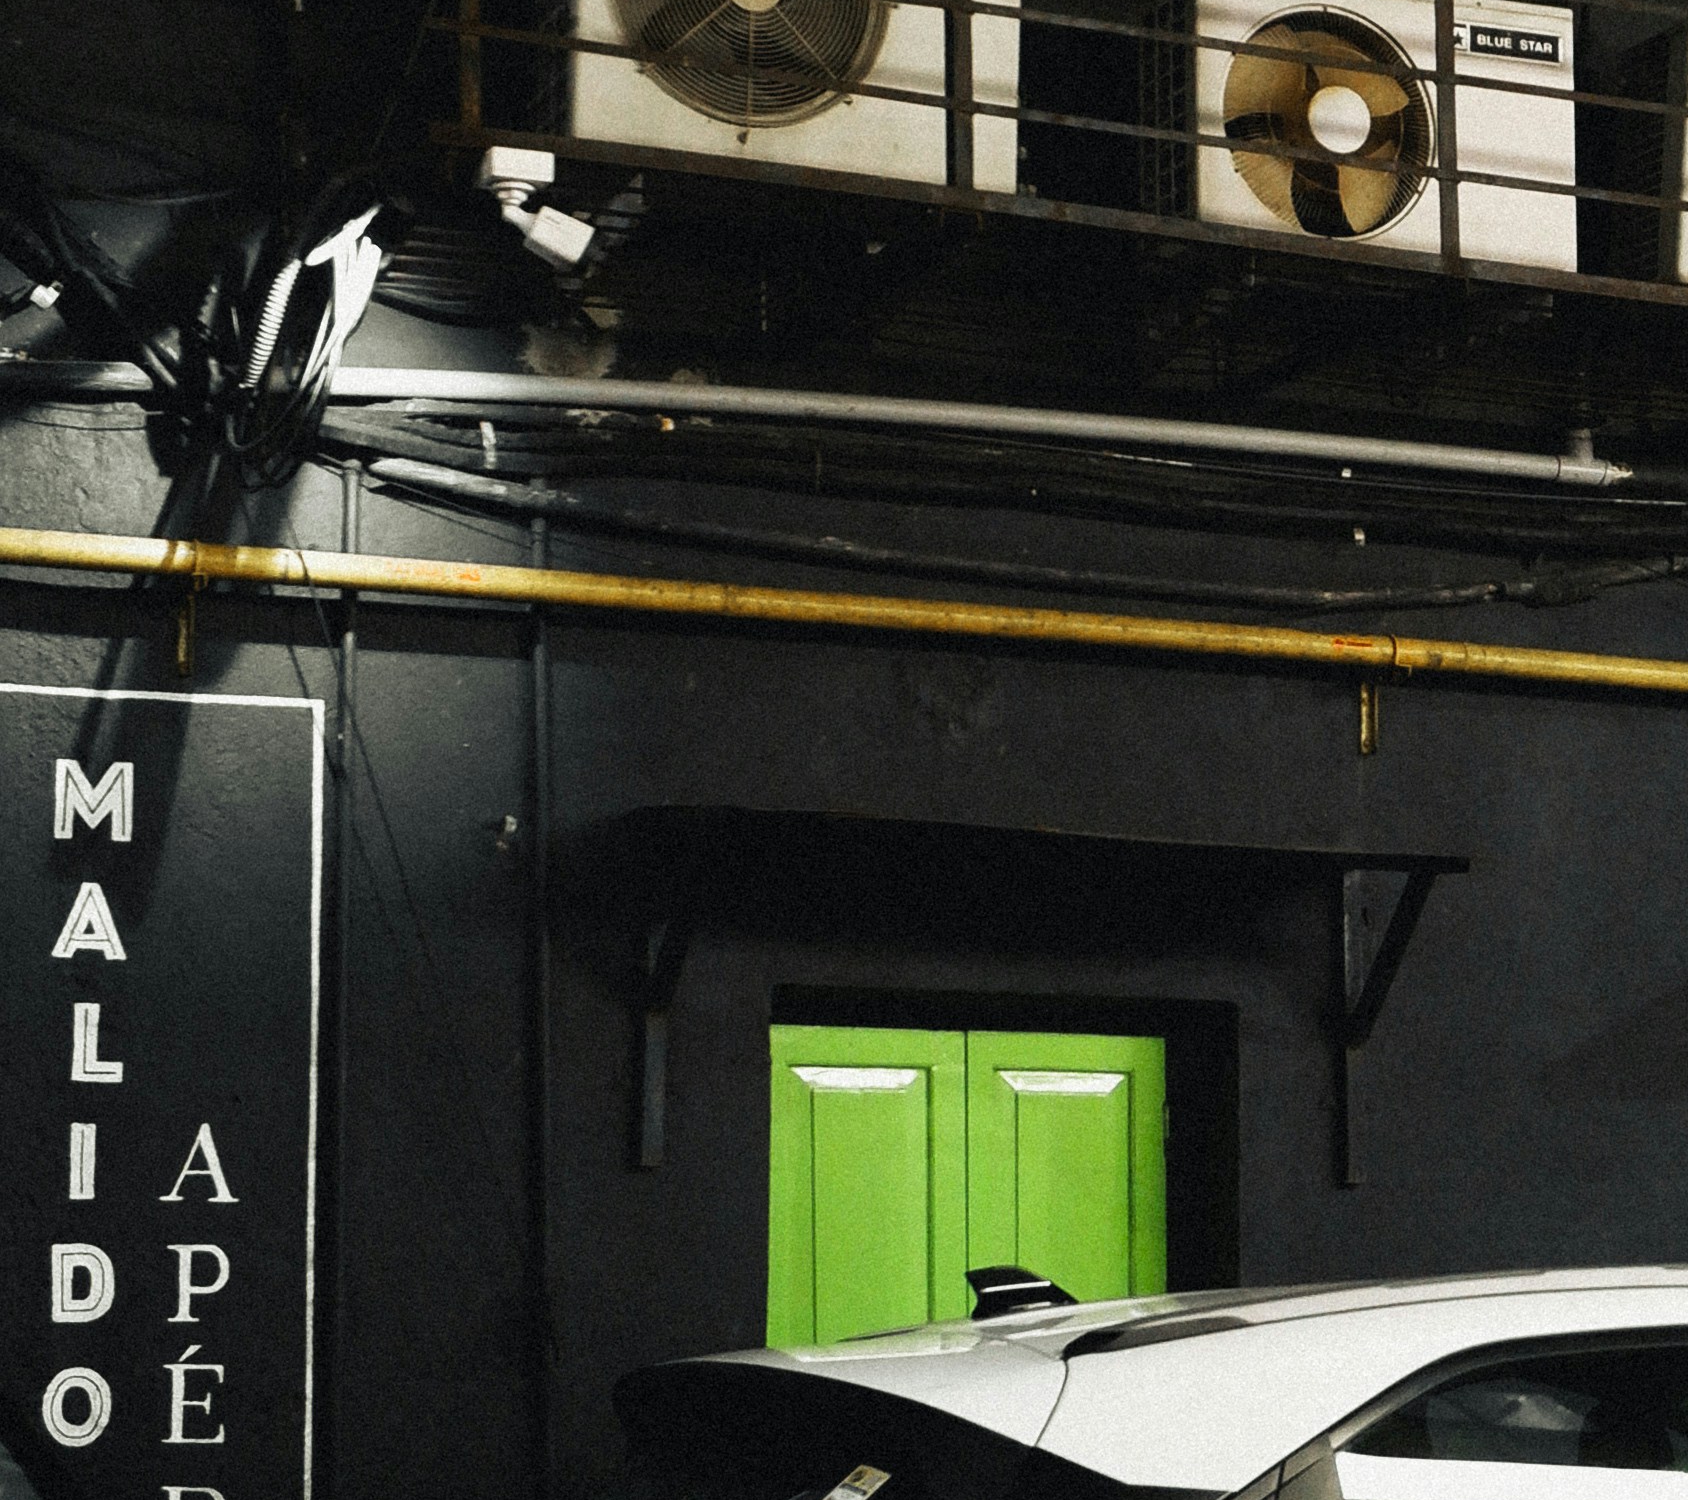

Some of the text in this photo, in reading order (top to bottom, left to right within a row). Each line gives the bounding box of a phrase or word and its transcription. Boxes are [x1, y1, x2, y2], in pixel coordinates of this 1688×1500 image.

[1476, 33, 1553, 54] BLUE STAR
[42, 757, 135, 1449] MALIDO
